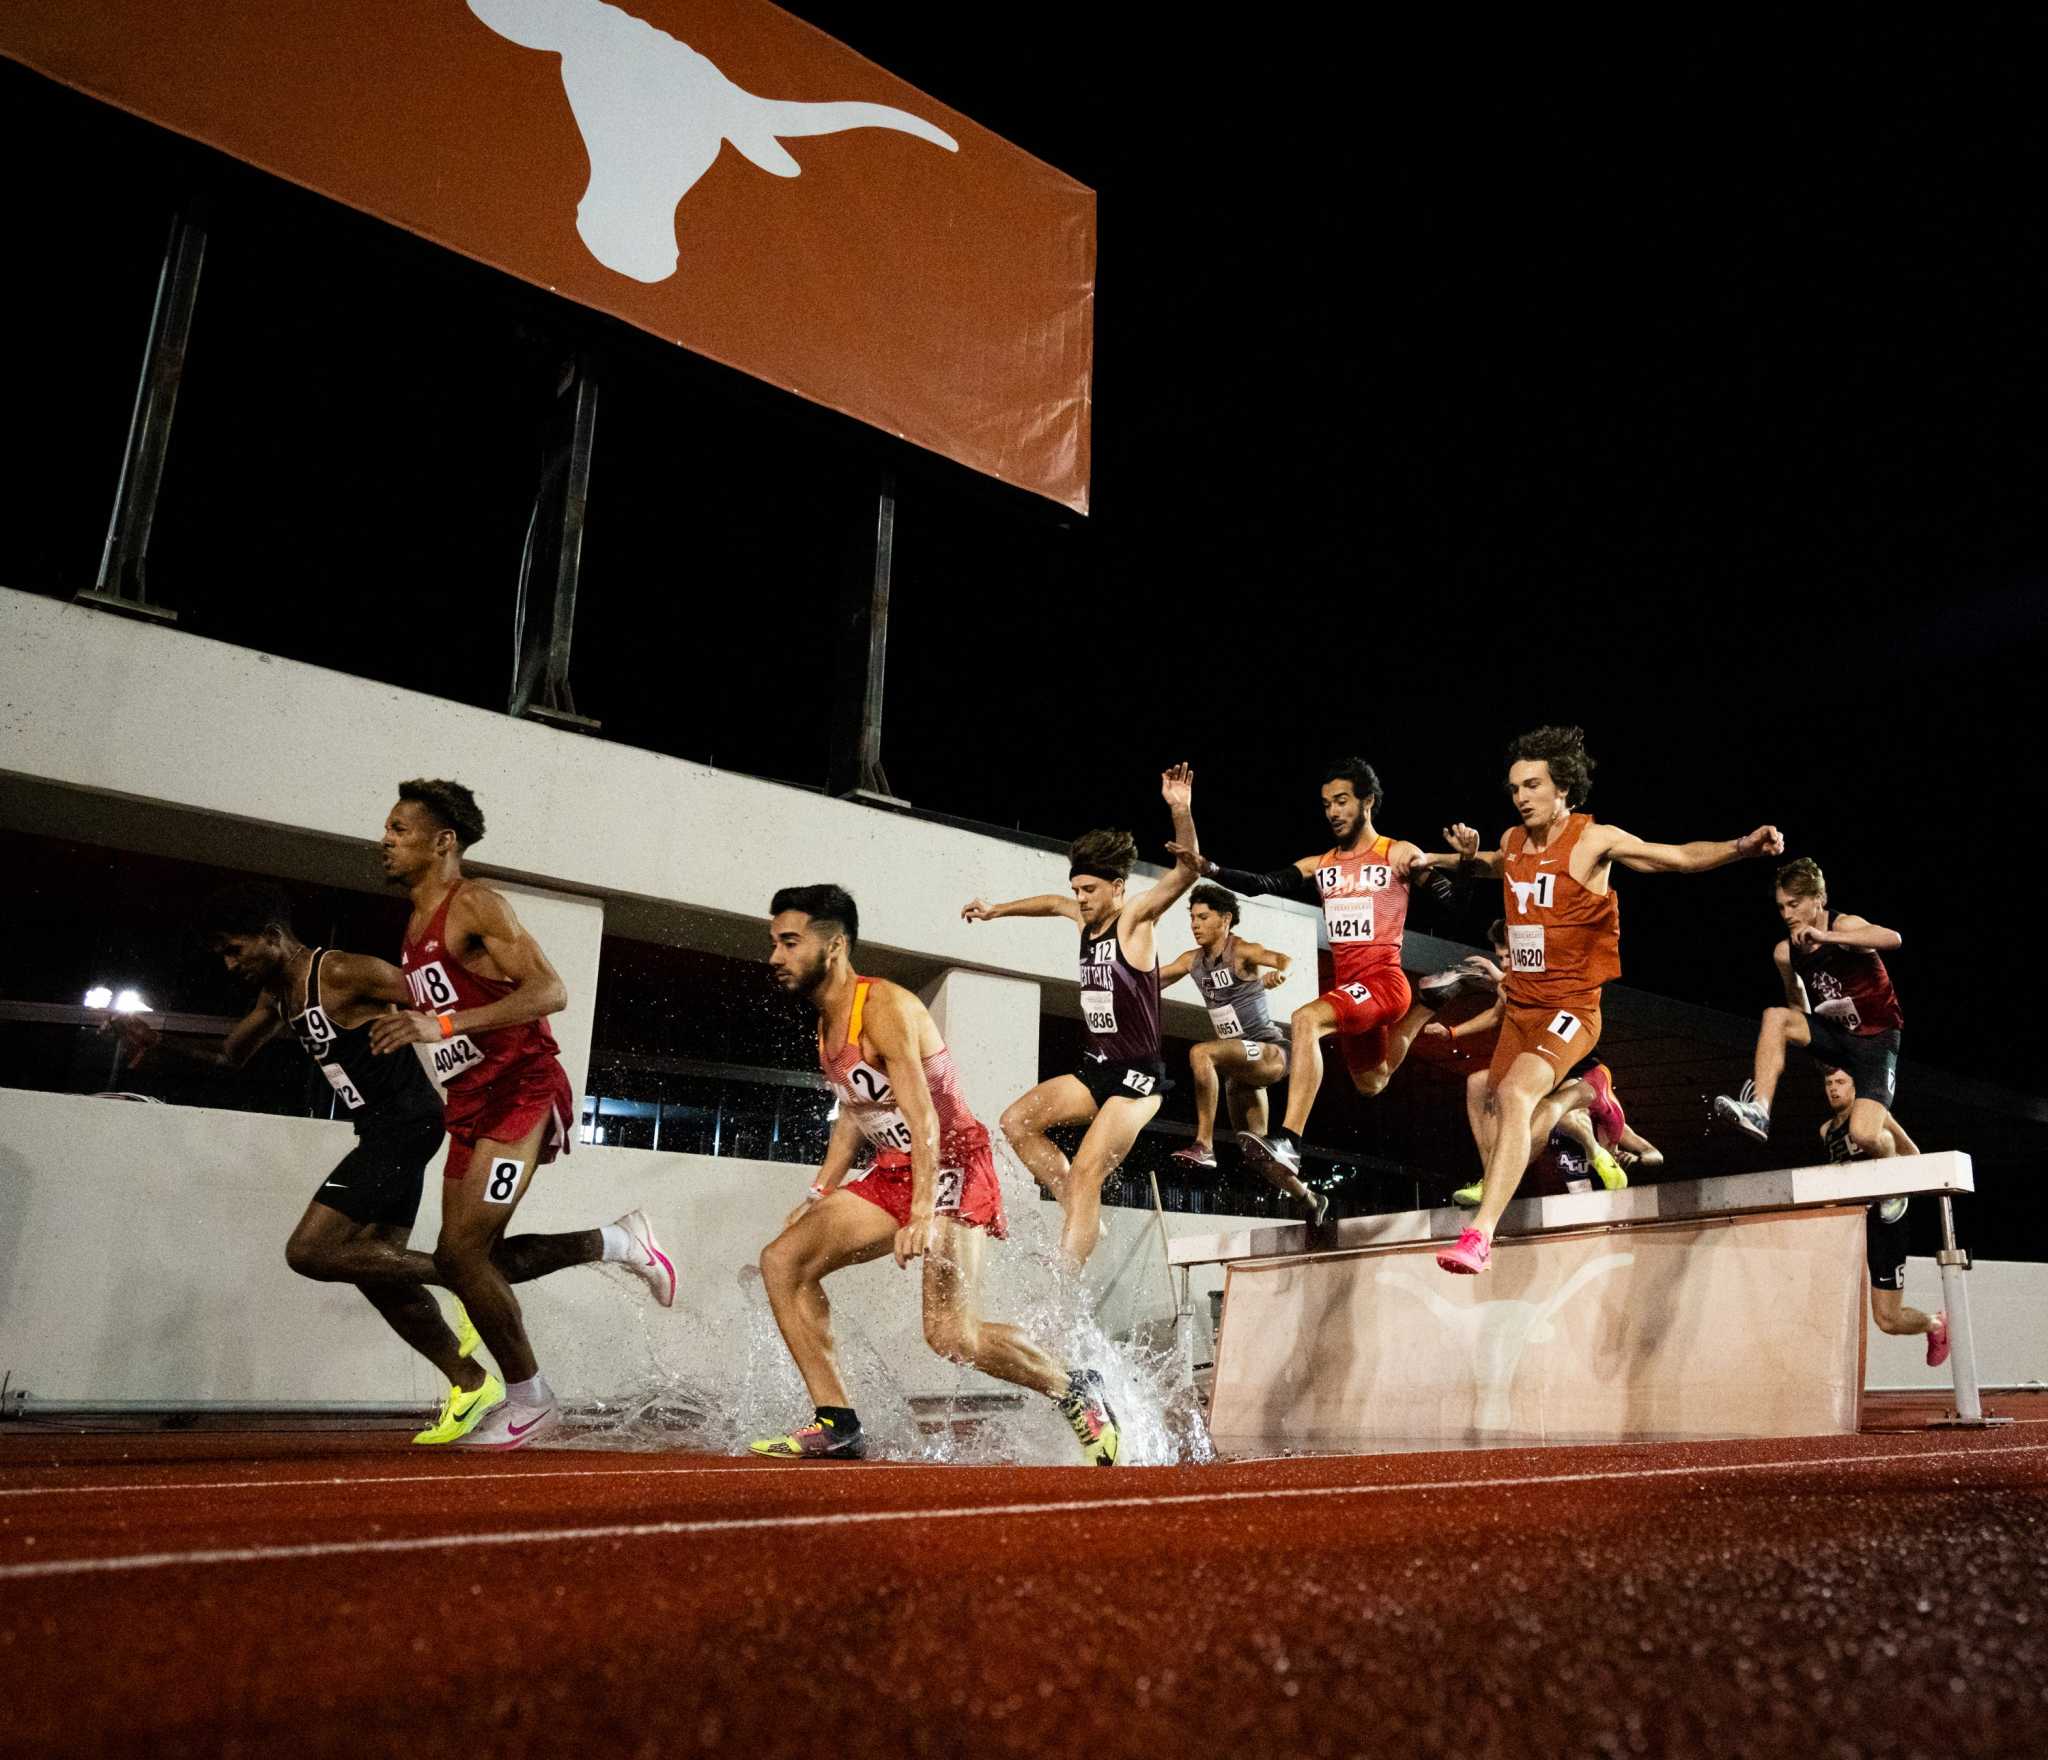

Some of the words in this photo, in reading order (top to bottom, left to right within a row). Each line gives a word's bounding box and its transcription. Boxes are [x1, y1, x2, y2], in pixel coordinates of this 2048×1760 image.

[1317, 867, 1337, 889] 13
[1363, 866, 1387, 887] 13
[1537, 876, 1547, 904] 1
[1328, 919, 1371, 937] 14214
[1099, 941, 1111, 961] 12
[1512, 948, 1542, 967] 14620
[425, 967, 450, 1003] 8
[1214, 970, 1229, 986] 10
[309, 1009, 329, 1040] 9
[1557, 1015, 1573, 1035] 1
[1246, 1043, 1260, 1057] 10
[851, 1068, 890, 1101] 2
[1131, 1073, 1150, 1092] 12
[1559, 1152, 1589, 1174] ACU
[490, 1162, 517, 1201] 8
[935, 1171, 958, 1207] 2
